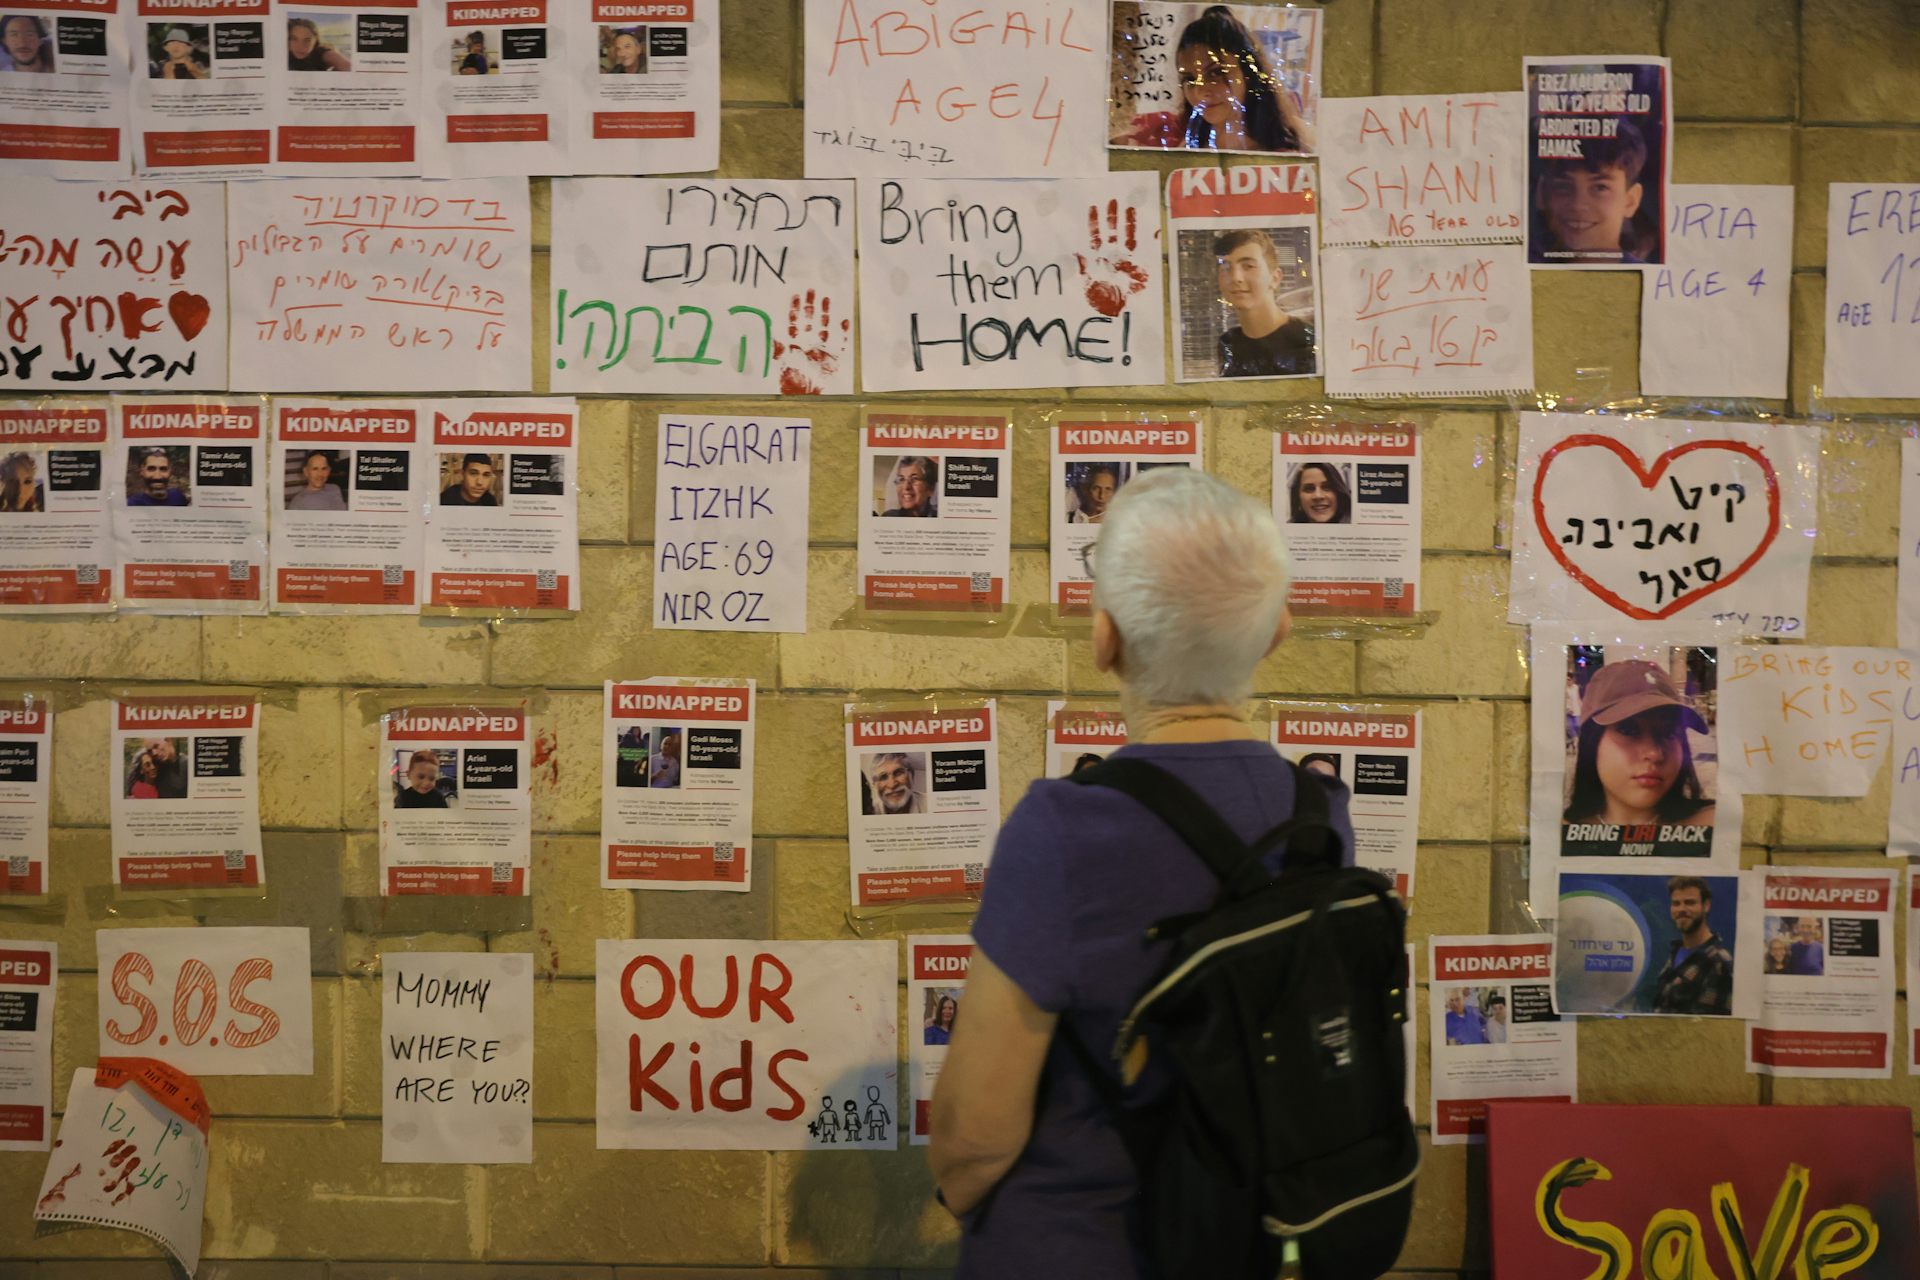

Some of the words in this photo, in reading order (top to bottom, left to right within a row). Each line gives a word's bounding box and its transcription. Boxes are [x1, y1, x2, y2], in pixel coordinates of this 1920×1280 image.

[452, 6, 540, 20] KIDNAPPED
[598, 4, 687, 17] KIDNAPPED
[98, 190, 190, 221] ביבי
[880, 181, 1022, 268] Bring
[1387, 214, 1415, 237] 16
[642, 243, 789, 288] אותם
[935, 253, 1063, 306] them
[1654, 268, 1727, 300] AGE
[1746, 267, 1767, 298] 4
[1837, 302, 1872, 327] AGE
[129, 412, 253, 430] KIDNAPPED
[286, 416, 410, 435] KIDNAPPED
[440, 421, 565, 439] KIDNAPPED
[874, 422, 1000, 441] KIDNAPPED
[1065, 429, 1190, 447] KIDNAPPED
[1287, 431, 1410, 448] KIDNAPPED
[664, 422, 811, 468] ELGARAT
[668, 485, 774, 521] ITZHK
[662, 591, 714, 624] NIR
[721, 590, 771, 622] OZ
[1852, 656, 1912, 680] OUR
[125, 704, 248, 721] KIDNAPPED
[618, 694, 742, 712] KIDNAPPED
[395, 716, 518, 732] KIDNAPPED
[859, 717, 984, 737] KIDNAPPED
[1285, 720, 1409, 739] KIDNAPPED
[1743, 730, 1877, 767] HOME
[466, 774, 493, 782] Israeli
[1565, 824, 1620, 842] BRING
[1658, 825, 1709, 843] BACK
[1619, 842, 1654, 855] NOW!
[1765, 885, 1880, 904] KIDNAPPED
[396, 970, 491, 1014] MOMMY
[619, 952, 795, 1025] OUR
[389, 1033, 503, 1063] WHERE
[395, 1076, 455, 1104] ARE
